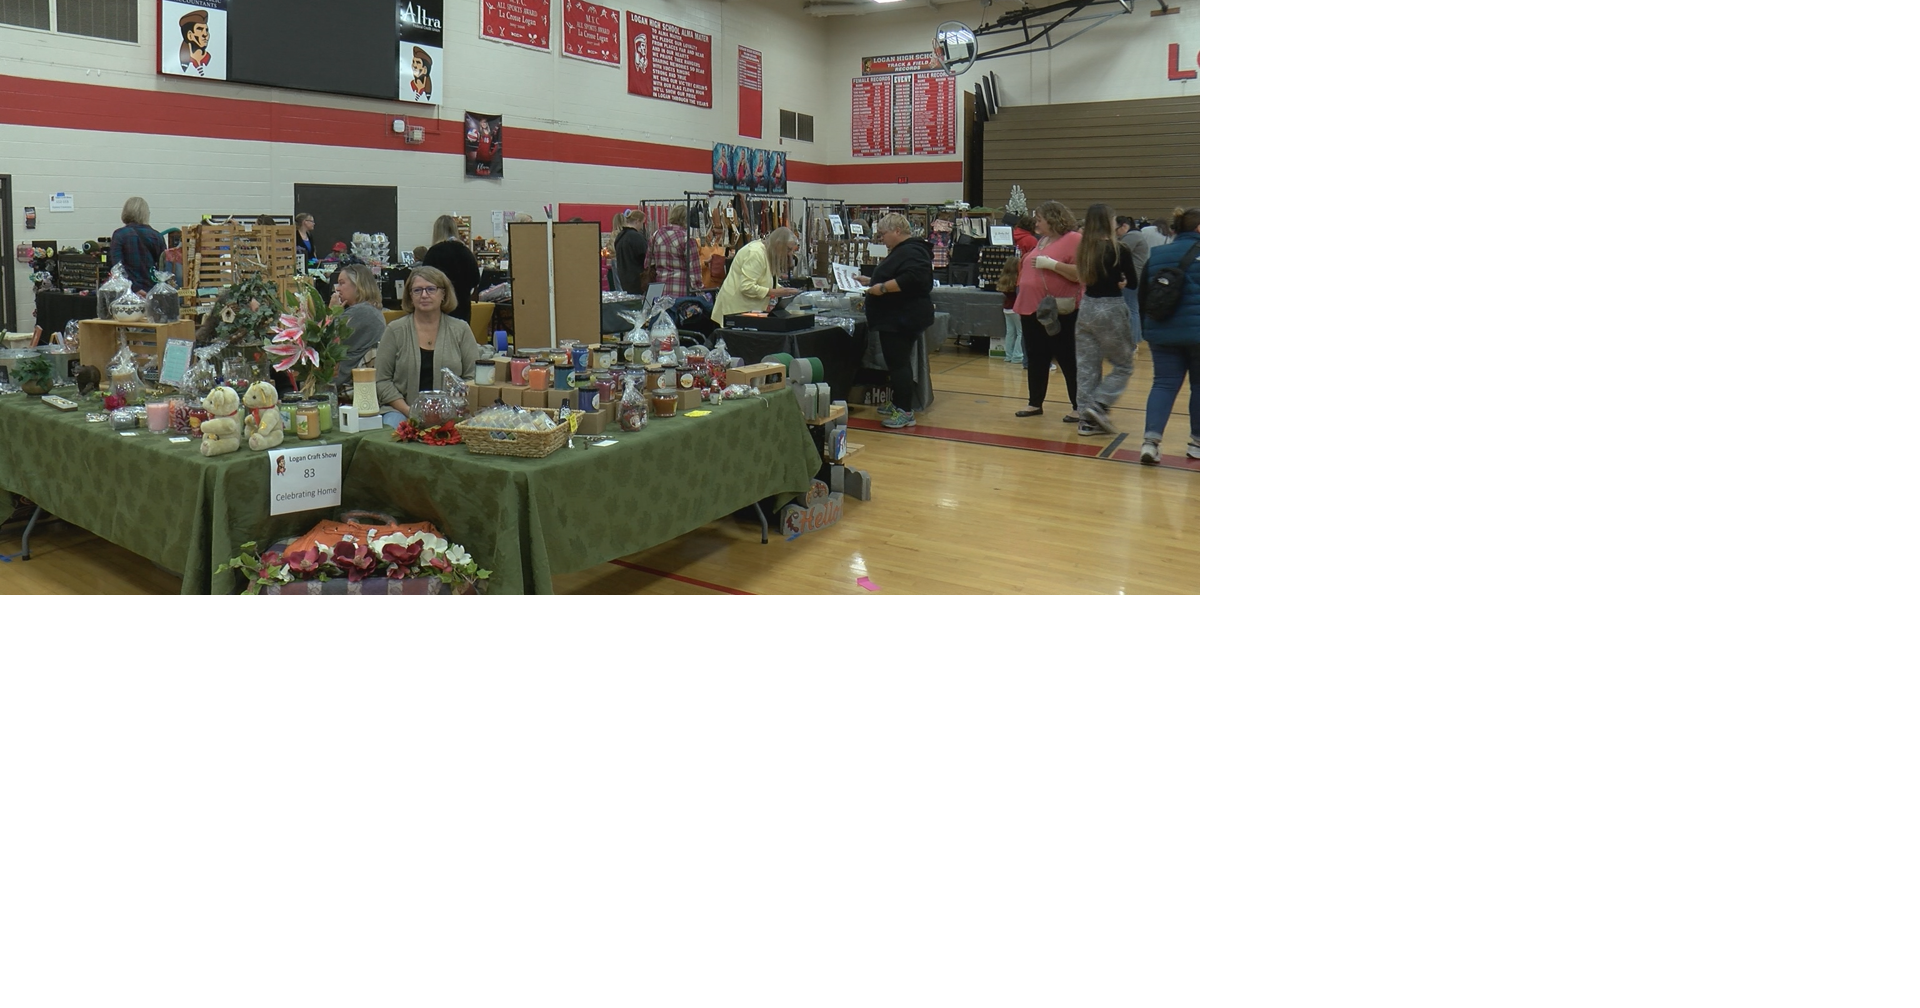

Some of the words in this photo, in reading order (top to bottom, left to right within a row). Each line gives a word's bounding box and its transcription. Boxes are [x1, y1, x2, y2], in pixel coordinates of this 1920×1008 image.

[497, 2, 506, 10] ALL
[506, 4, 522, 13] SPORTS
[403, 1, 442, 29] Altra
[499, 10, 505, 18] La
[522, 15, 536, 27] Logan
[631, 13, 648, 25] LOGAN
[649, 19, 661, 29] HIGH
[662, 23, 680, 35] SCHOOL
[681, 29, 694, 38] ALMA
[695, 32, 709, 43] MATER
[896, 54, 914, 62] HIGH
[1168, 43, 1200, 81] L
[289, 455, 306, 463] Logan
[304, 468, 316, 479] 83
[275, 490, 316, 501] Celebrating
[317, 487, 337, 495] Home
